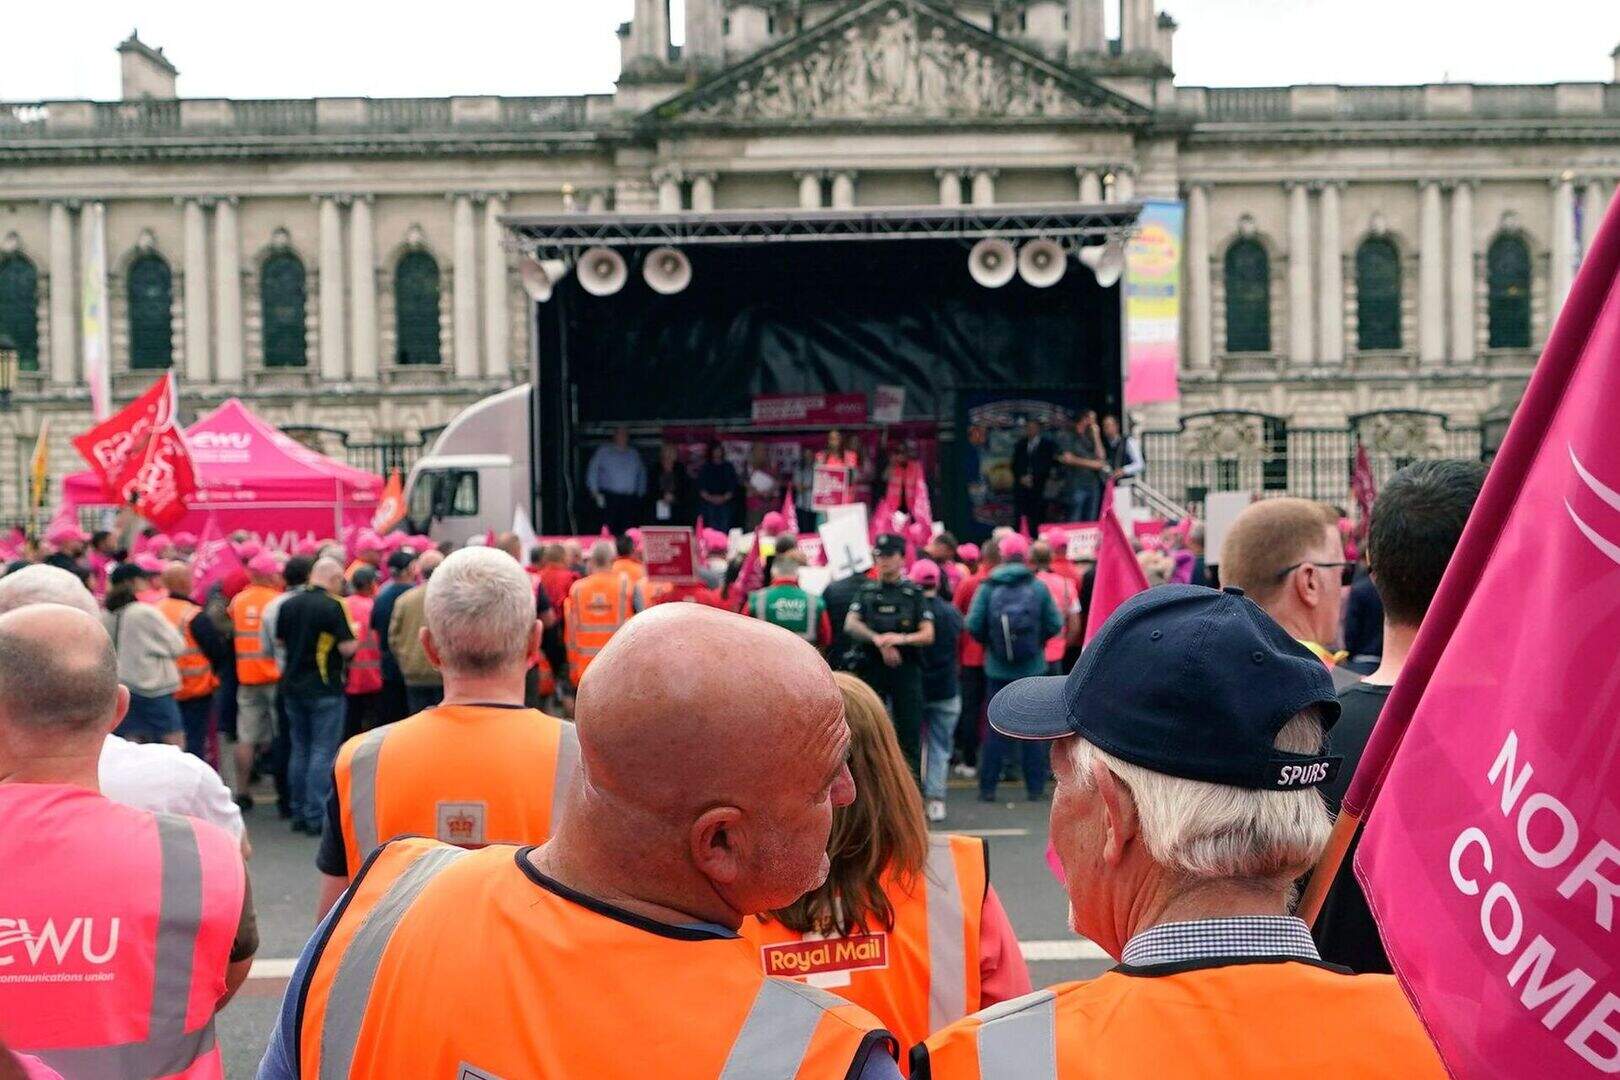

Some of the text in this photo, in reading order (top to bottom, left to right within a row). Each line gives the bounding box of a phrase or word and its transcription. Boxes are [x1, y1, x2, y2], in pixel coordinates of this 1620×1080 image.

[1277, 762, 1329, 786] SPURS
[770, 938, 881, 972] Royal Mail
[1449, 826, 1620, 1074] COMB
[84, 972, 115, 982] union
